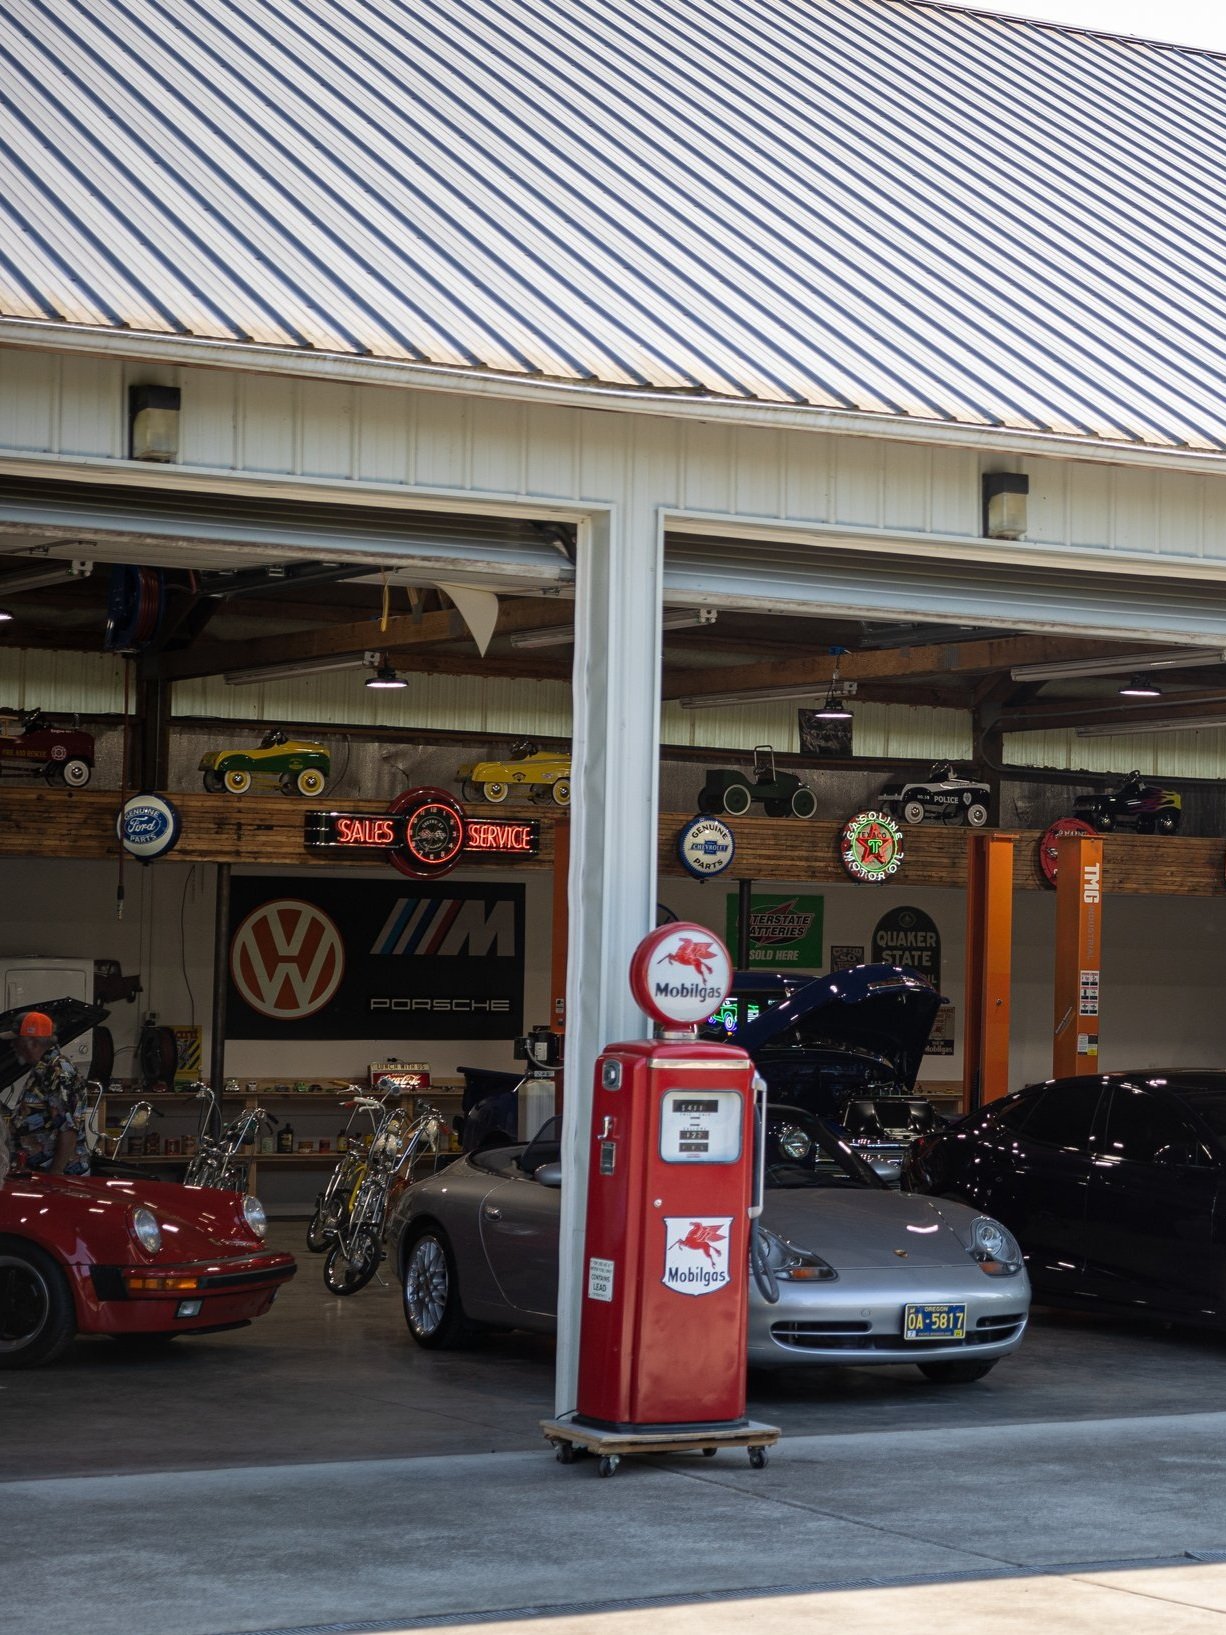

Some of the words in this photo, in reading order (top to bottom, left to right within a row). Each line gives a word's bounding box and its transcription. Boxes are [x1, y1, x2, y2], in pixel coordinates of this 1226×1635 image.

[933, 796, 959, 804] POLICE
[124, 807, 160, 820] GENUINE
[127, 815, 157, 832] Ford
[846, 811, 903, 840] GASOLINE
[130, 833, 158, 843] PARTS
[337, 820, 394, 844] SALES
[469, 824, 531, 849] SERVICE
[691, 823, 729, 841] GENUINE
[692, 844, 727, 852] CHEVROLET
[693, 858, 723, 870] PARTS
[844, 850, 886, 880] MOTOR
[888, 852, 904, 873] OIL
[1084, 862, 1100, 904] TMG
[750, 914, 811, 926] TERSTATE
[749, 926, 805, 937] ATTERIES
[876, 931, 937, 948] QUAKER
[749, 949, 773, 961] SOLD
[775, 950, 800, 961] HERE
[881, 951, 932, 967] STATE
[655, 982, 722, 1003] Mobilgas
[370, 998, 510, 1012] PORSCHE
[668, 1266, 726, 1287] Mobilgas
[592, 1283, 607, 1292] LEAD
